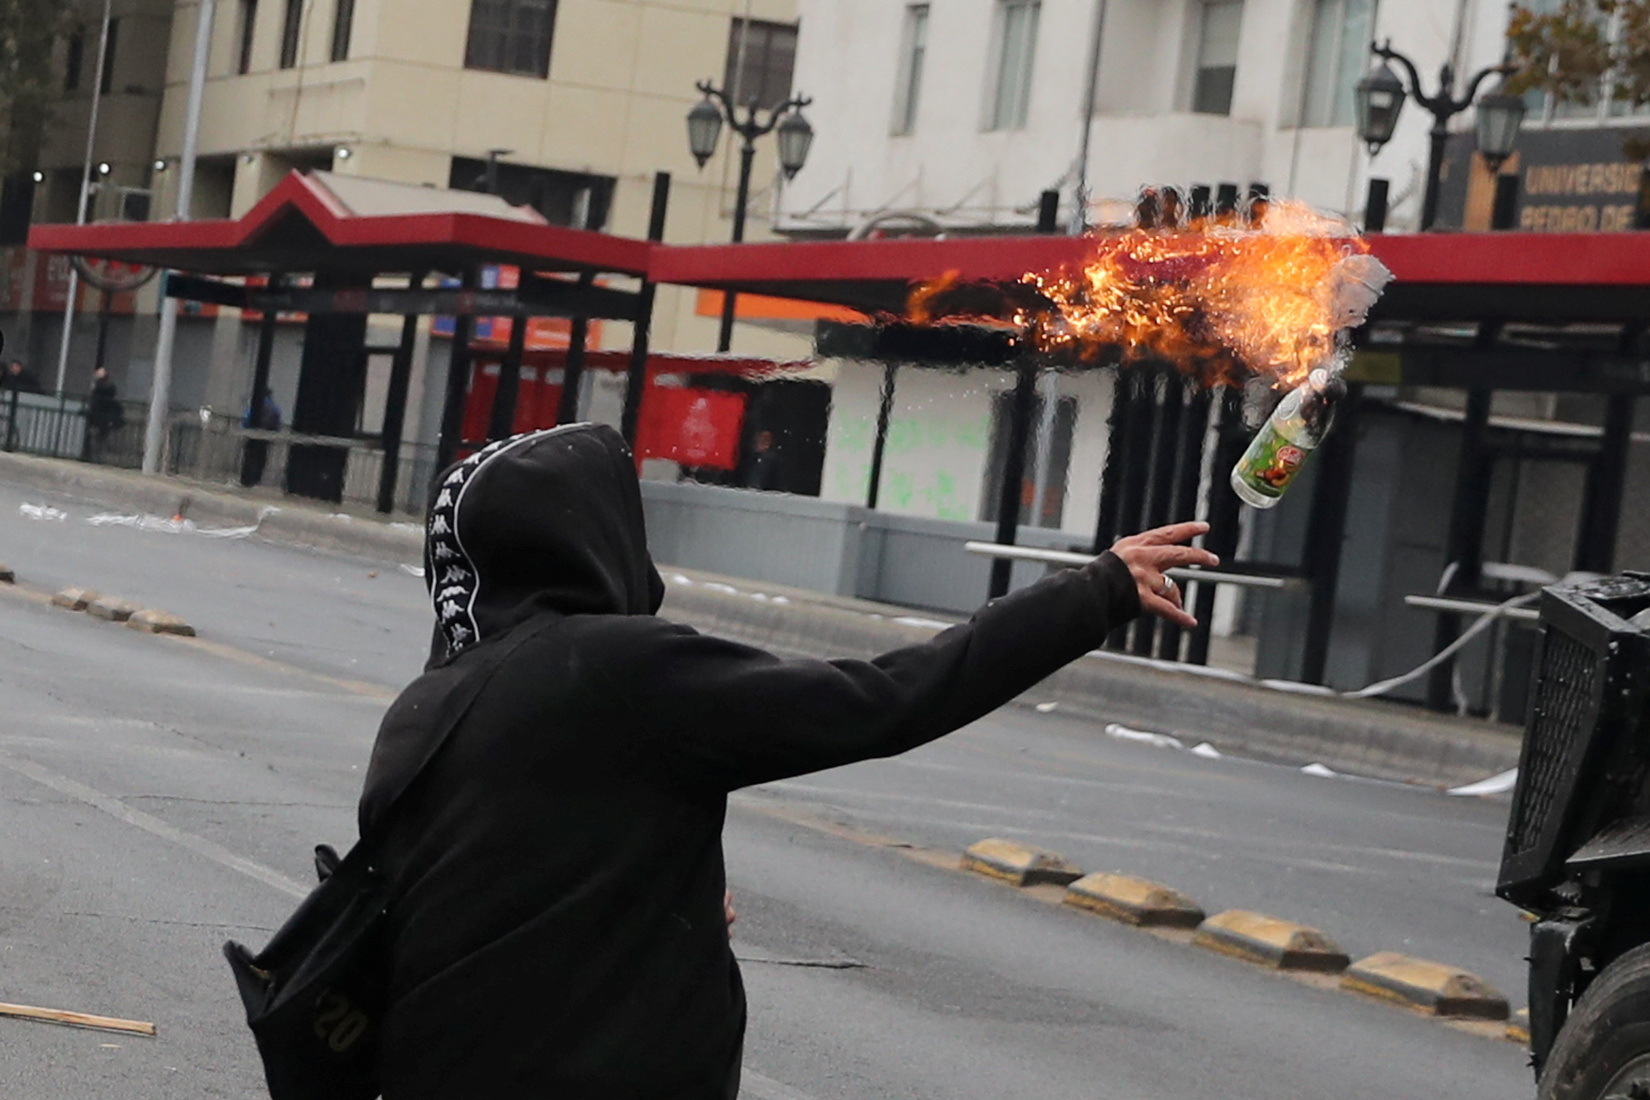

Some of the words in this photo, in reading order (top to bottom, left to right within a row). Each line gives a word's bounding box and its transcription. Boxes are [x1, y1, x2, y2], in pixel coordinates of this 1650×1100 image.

[1520, 205, 1598, 232] PEDRO
[1601, 204, 1635, 232] DE
[313, 994, 369, 1052] 20
